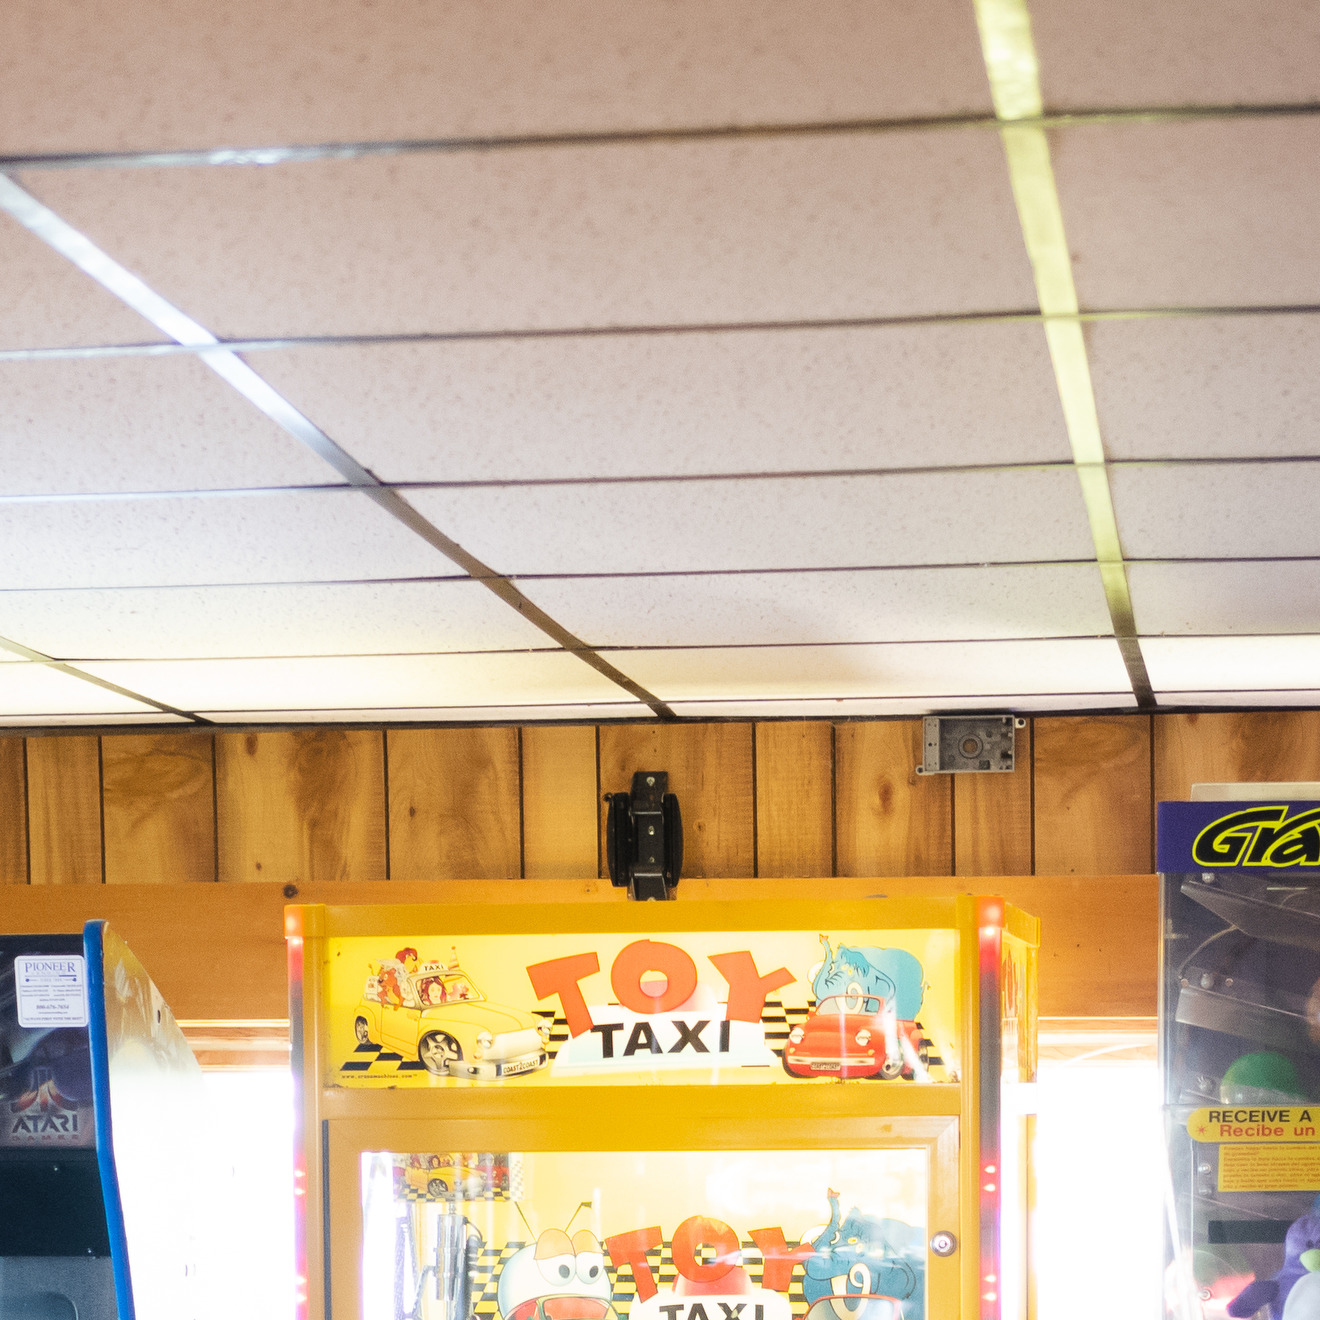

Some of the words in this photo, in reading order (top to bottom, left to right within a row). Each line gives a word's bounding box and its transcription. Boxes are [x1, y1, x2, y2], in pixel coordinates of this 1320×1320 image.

[25, 961, 76, 973] PIONEER
[423, 964, 444, 972] TAXI
[526, 938, 797, 1040] TOY
[590, 1020, 730, 1059] TAXI
[502, 1059, 540, 1075] COAST2COAST
[12, 1113, 79, 1133] ATARI
[1208, 1110, 1290, 1123] RECEIVE
[1299, 1110, 1312, 1122] A
[1219, 1124, 1285, 1137] Recibe
[1293, 1126, 1316, 1137] un
[605, 1215, 816, 1303] TOY
